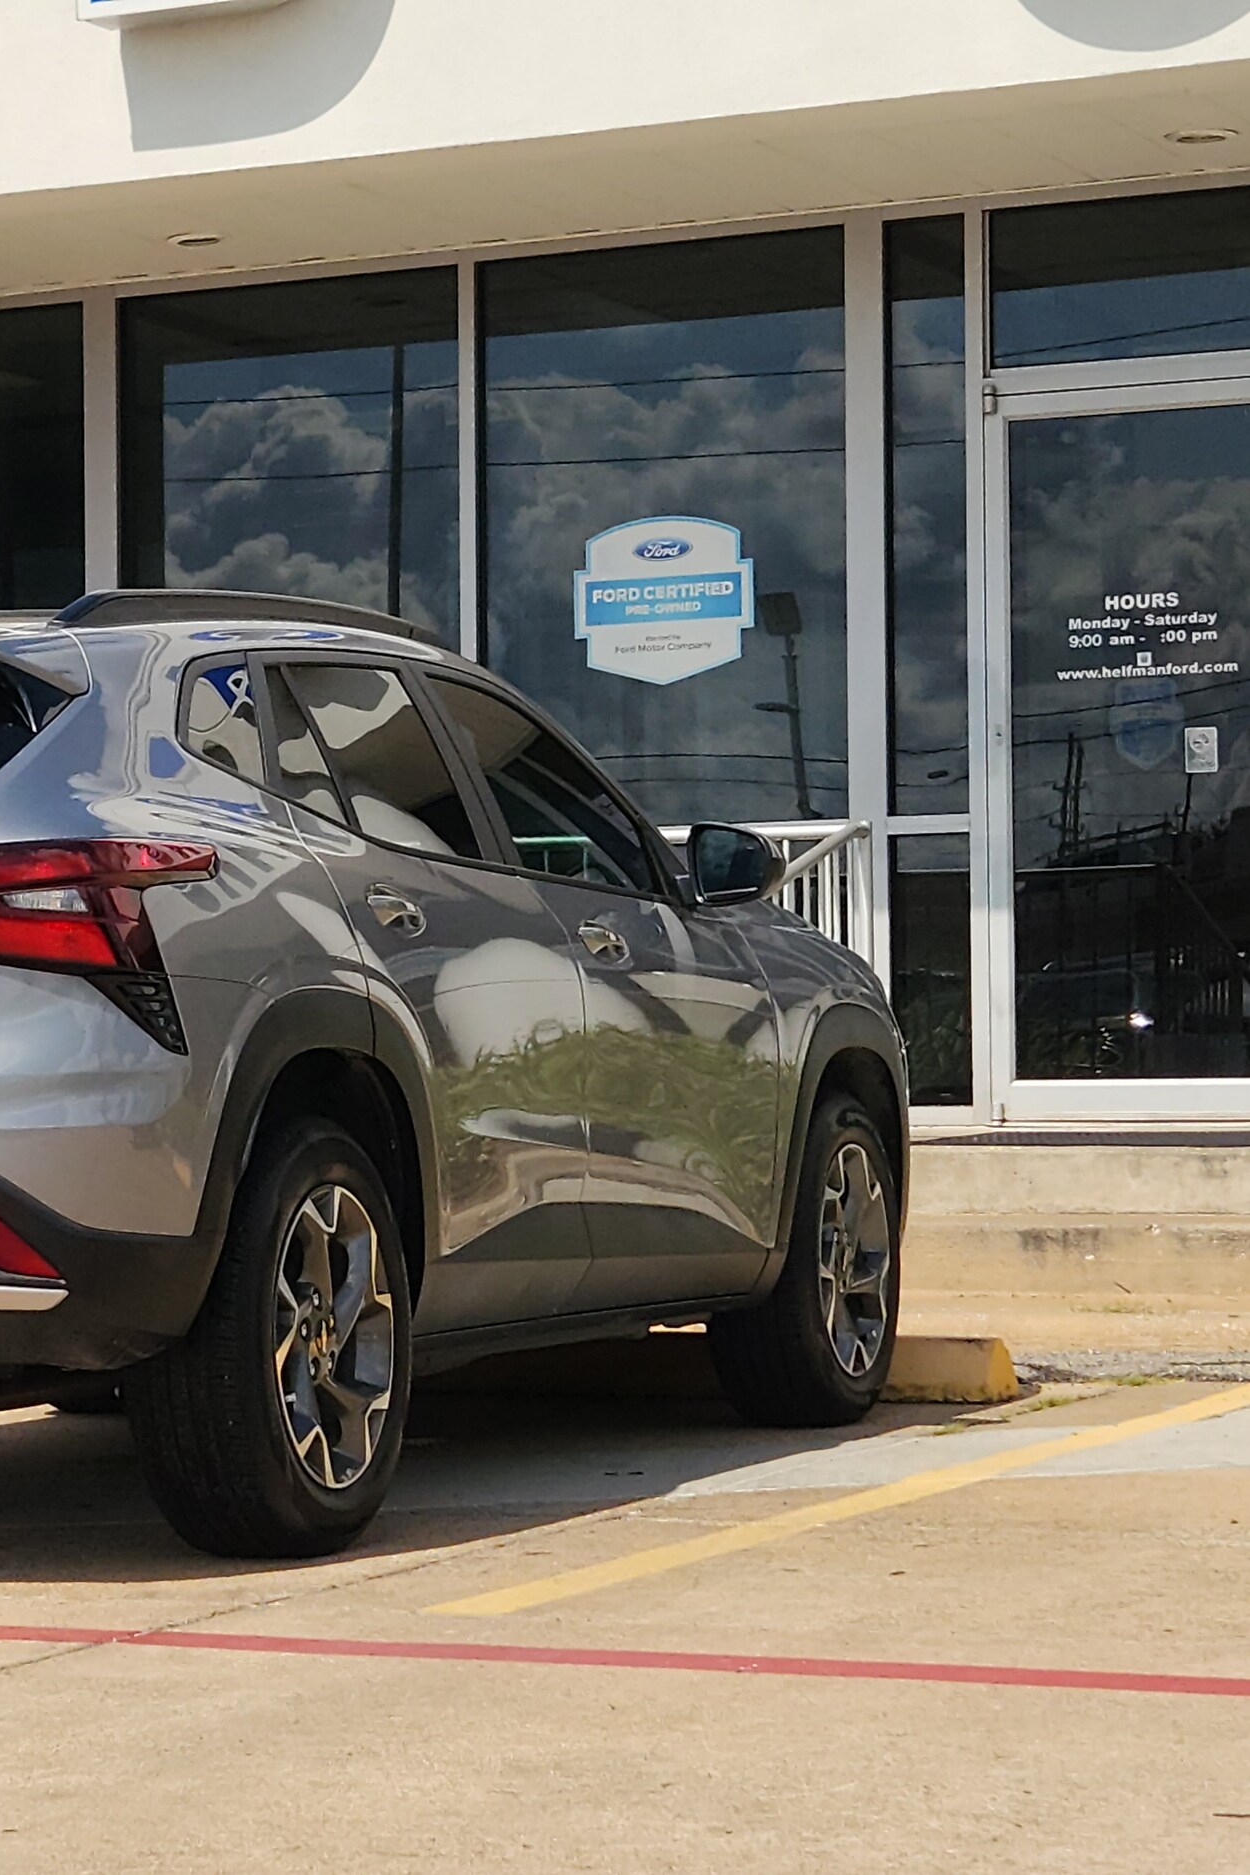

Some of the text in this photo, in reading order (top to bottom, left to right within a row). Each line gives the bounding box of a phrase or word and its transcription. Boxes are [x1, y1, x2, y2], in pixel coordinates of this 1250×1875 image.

[643, 540, 681, 558] Ford
[592, 581, 734, 604] FORD CERTIFIED
[1104, 592, 1180, 611] HOURS
[625, 601, 702, 616] PRE-OWNED
[1068, 616, 1130, 631] Monday
[1144, 611, 1218, 626] Saturday
[1068, 634, 1102, 648] 9:00
[1108, 634, 1135, 646] am
[1191, 630, 1218, 644] pm
[1057, 662, 1239, 681] www.helfmanford.com
